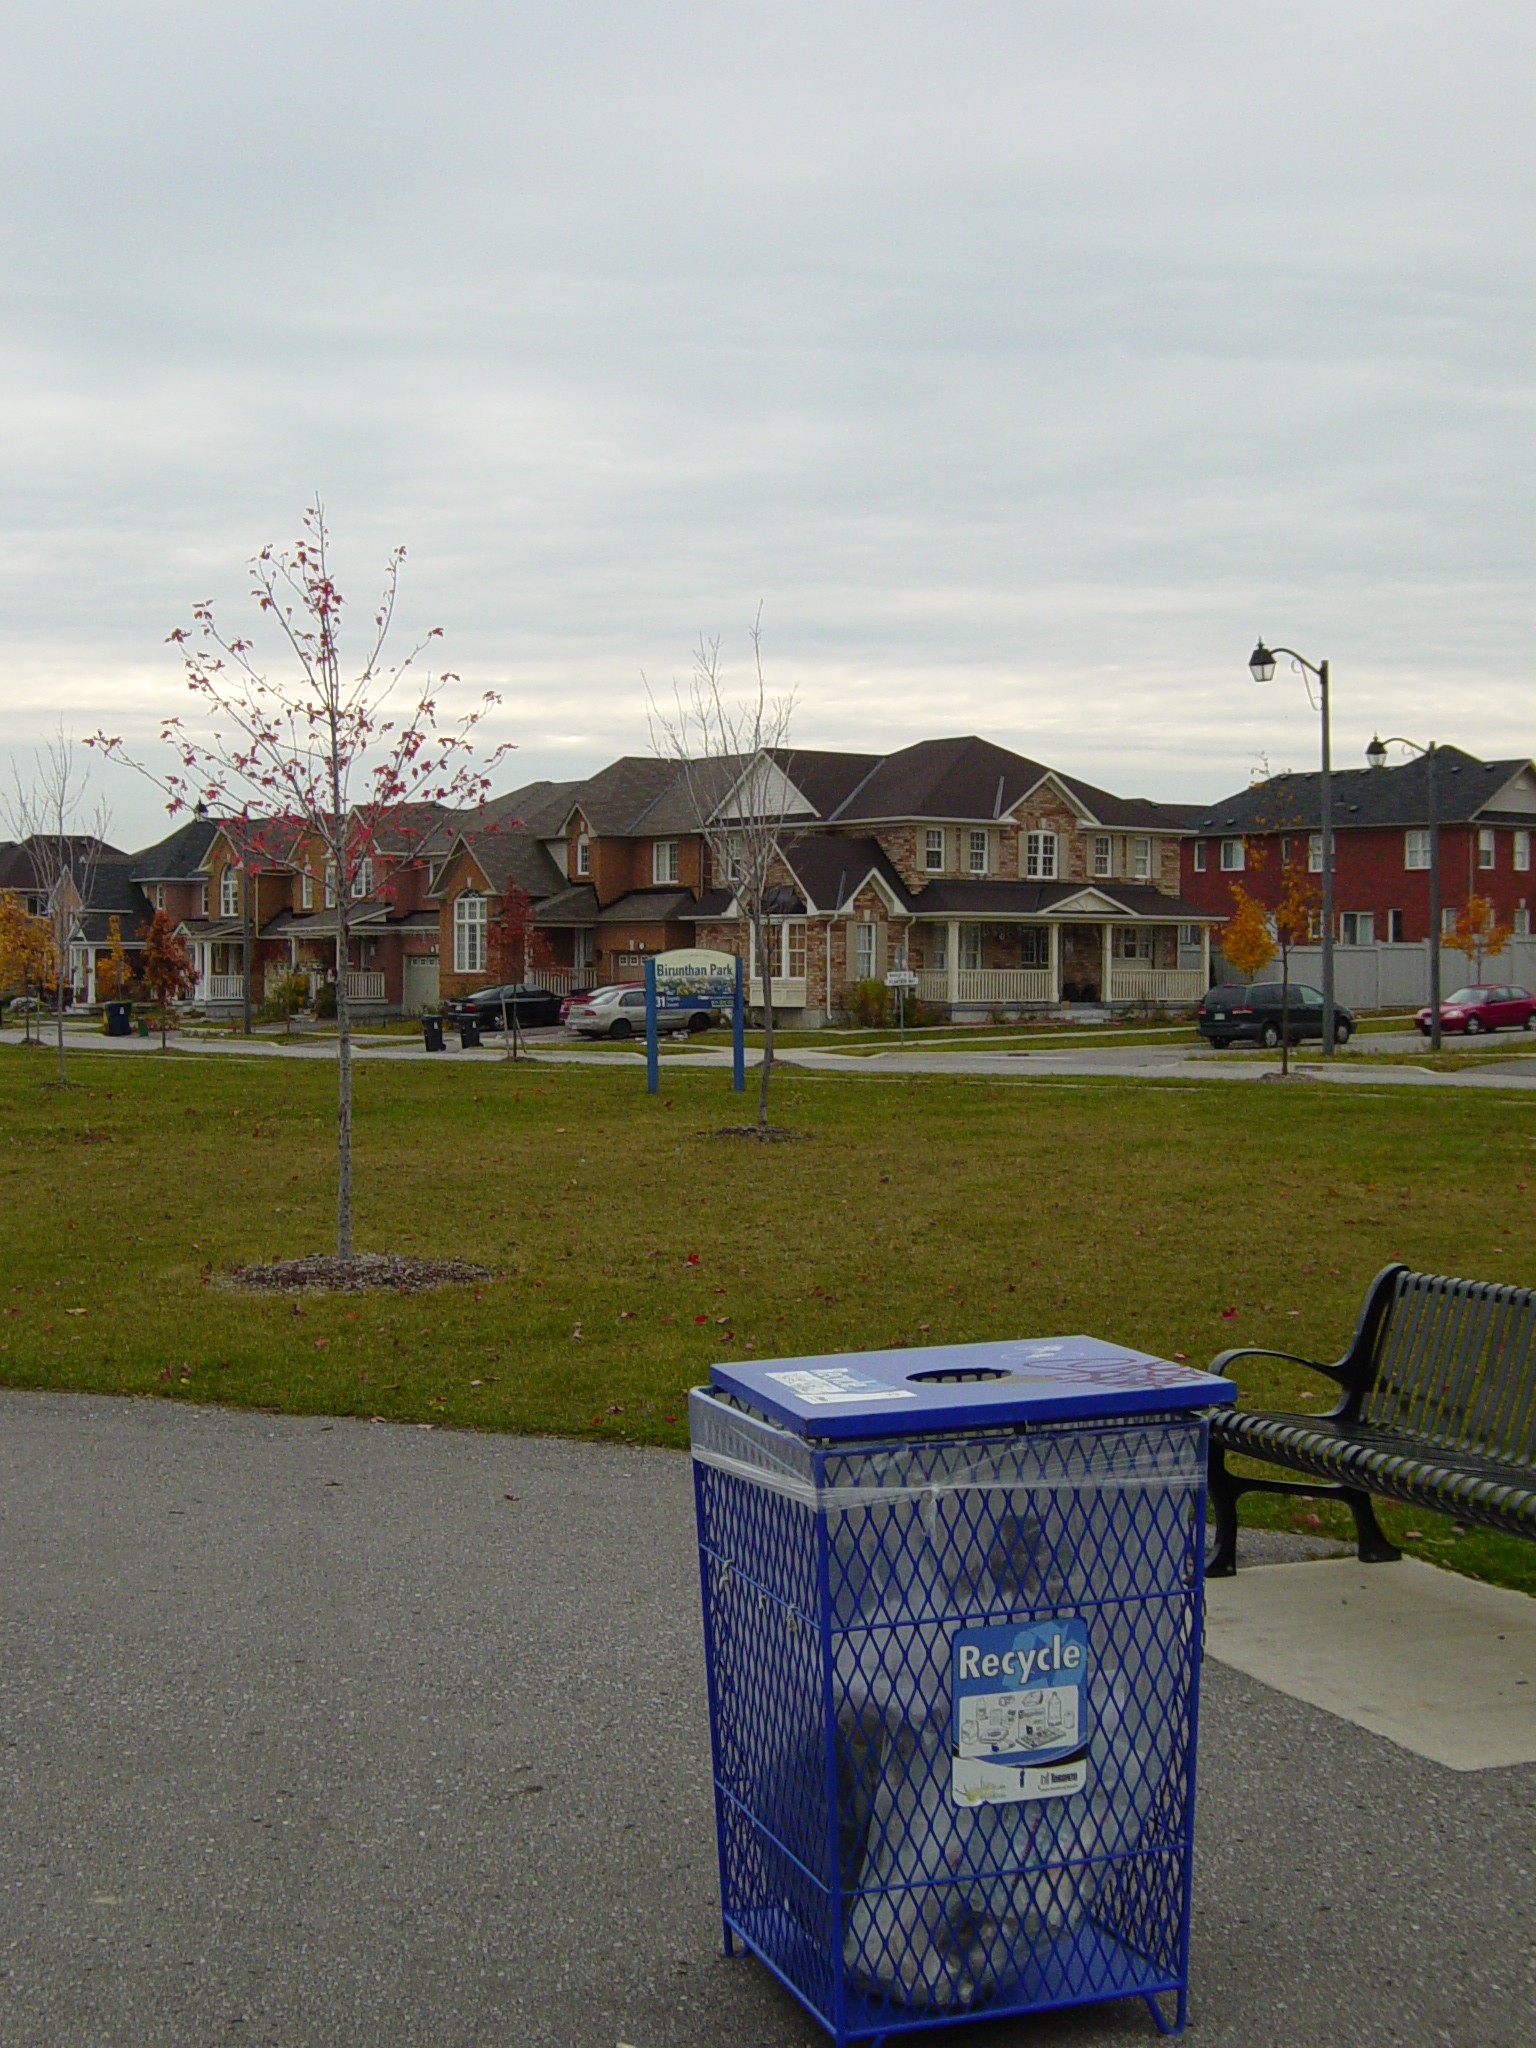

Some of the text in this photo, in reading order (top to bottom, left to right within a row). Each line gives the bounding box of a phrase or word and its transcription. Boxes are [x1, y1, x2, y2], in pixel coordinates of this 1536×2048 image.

[657, 963, 733, 976] Birunthan Park
[958, 1633, 1081, 1685] Recycle
